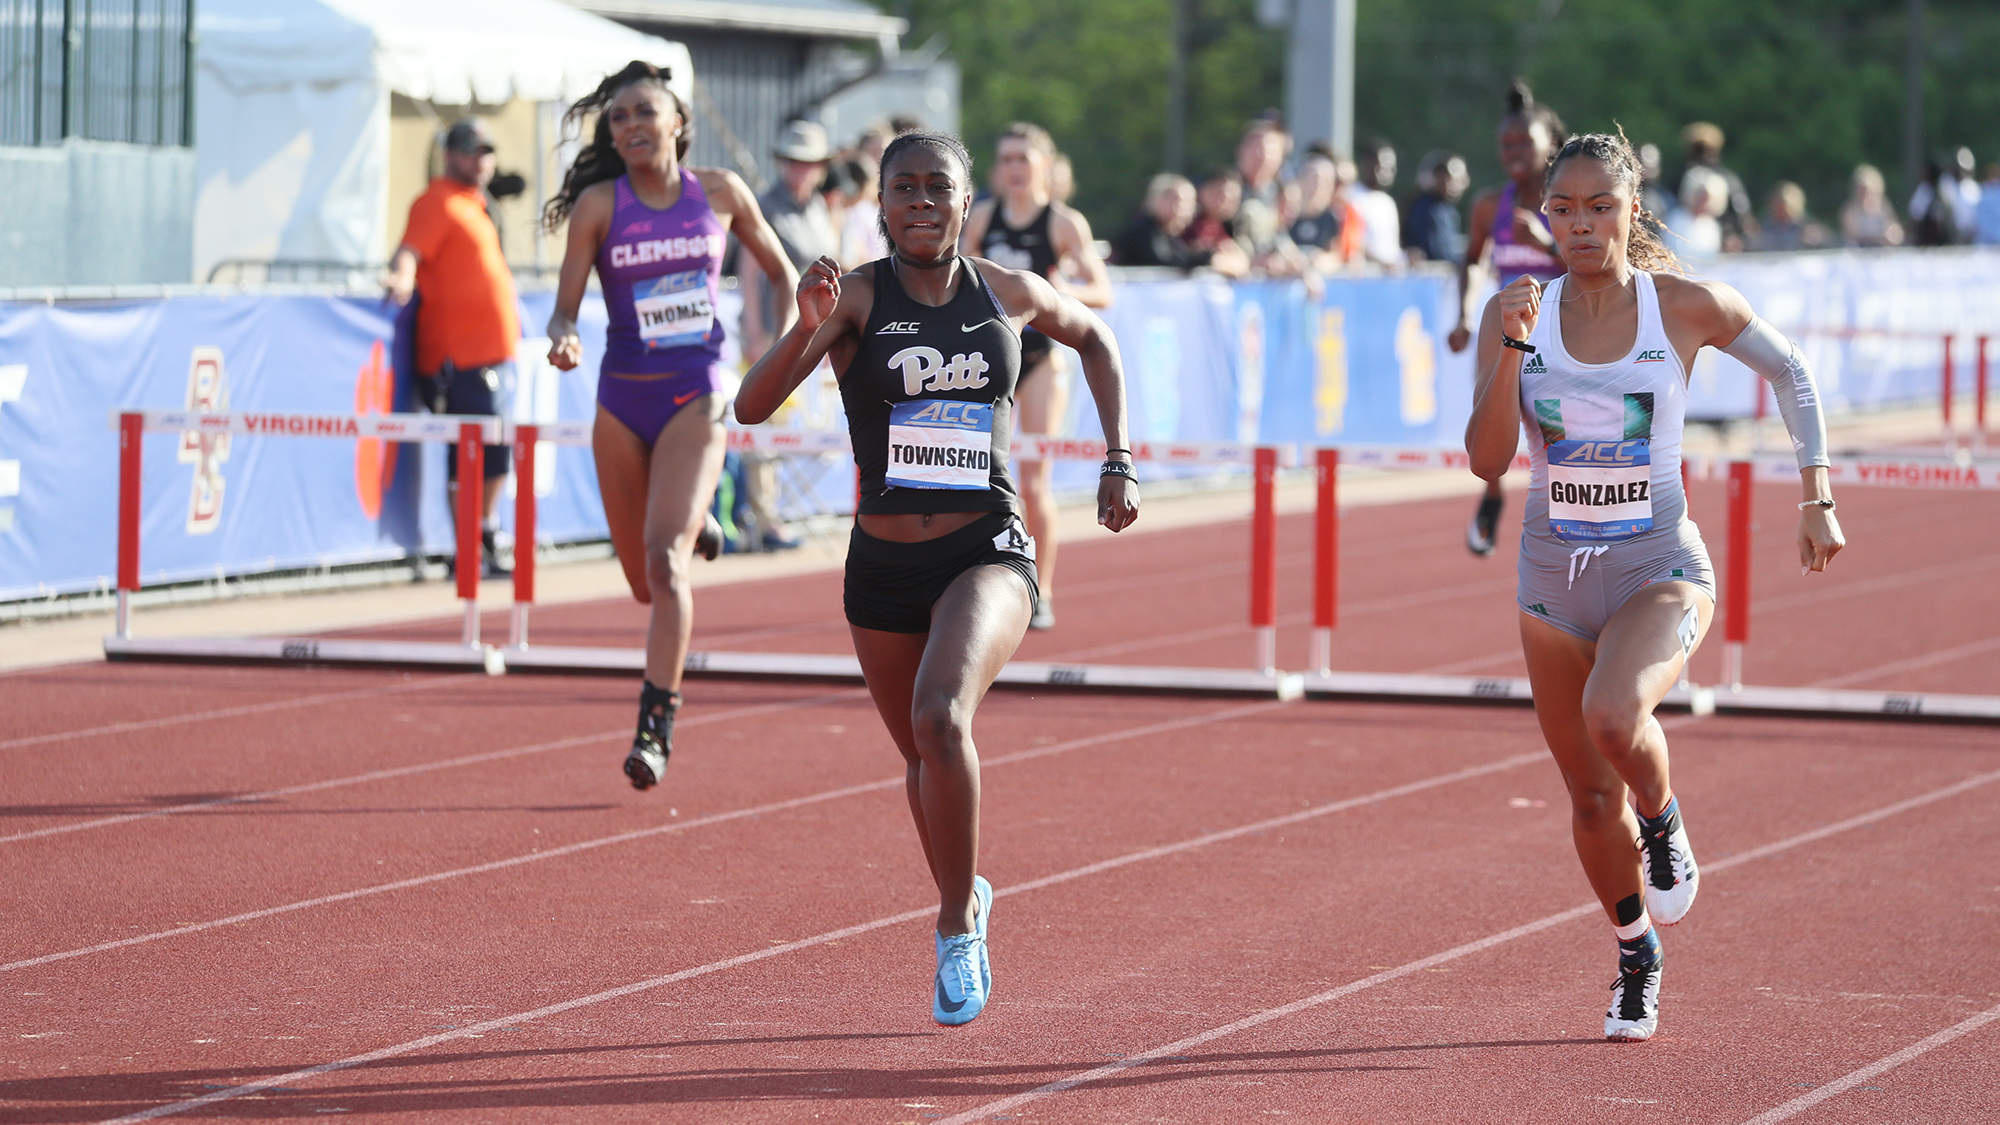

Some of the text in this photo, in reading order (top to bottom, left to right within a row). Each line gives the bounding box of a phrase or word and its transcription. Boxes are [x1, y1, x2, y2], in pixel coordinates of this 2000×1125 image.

[611, 235, 721, 268] CLEMSON
[649, 270, 698, 295] ACC
[641, 300, 710, 327] THOMAS
[879, 321, 921, 332] ACC
[1636, 350, 1666, 361] ACC
[888, 345, 990, 396] Pitt
[1523, 365, 1548, 374] adidas
[243, 413, 360, 436] VIRGINIA
[910, 402, 985, 424] ACC
[892, 443, 989, 471] TOWNSEND
[1564, 441, 1638, 461] ACC
[1857, 463, 1980, 488] VIRGINIA
[1550, 480, 1649, 507] GONZALEZ
